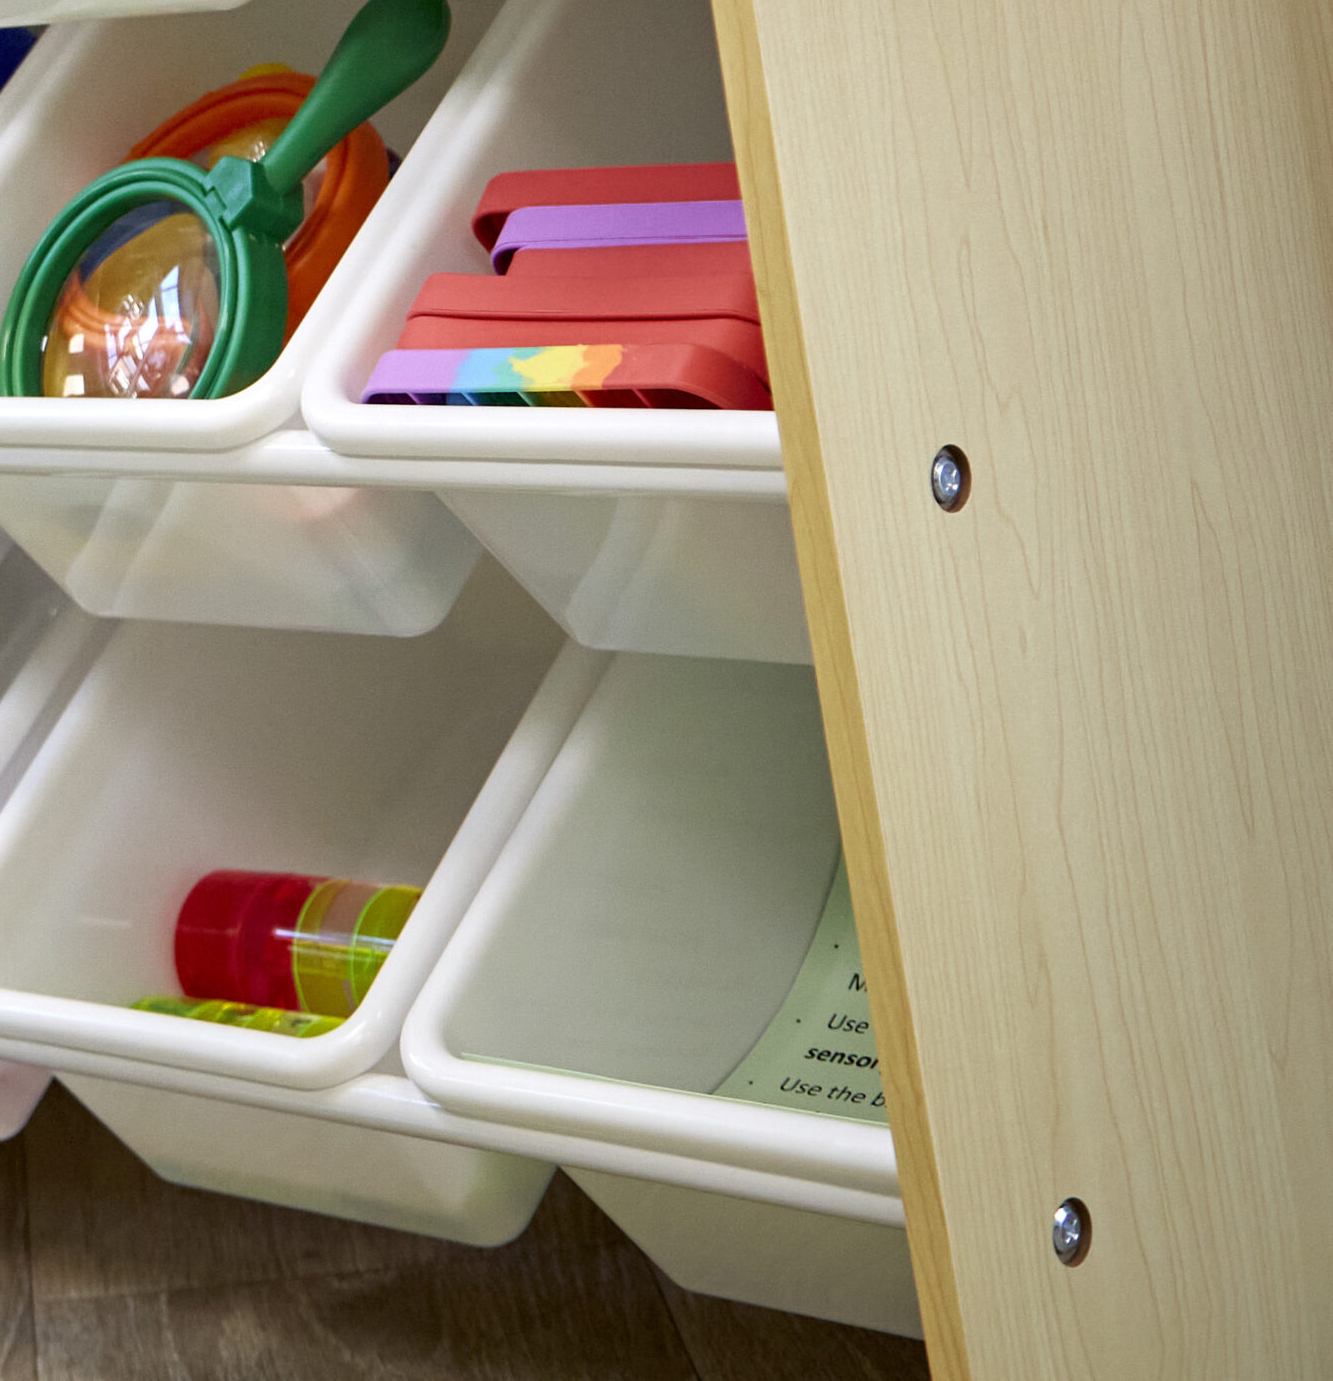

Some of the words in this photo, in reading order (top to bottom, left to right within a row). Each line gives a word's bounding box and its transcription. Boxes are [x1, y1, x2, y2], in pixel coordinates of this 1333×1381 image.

[827, 1012, 869, 1035] Use
[779, 1076, 823, 1097] Use
[826, 1085, 867, 1105] the
